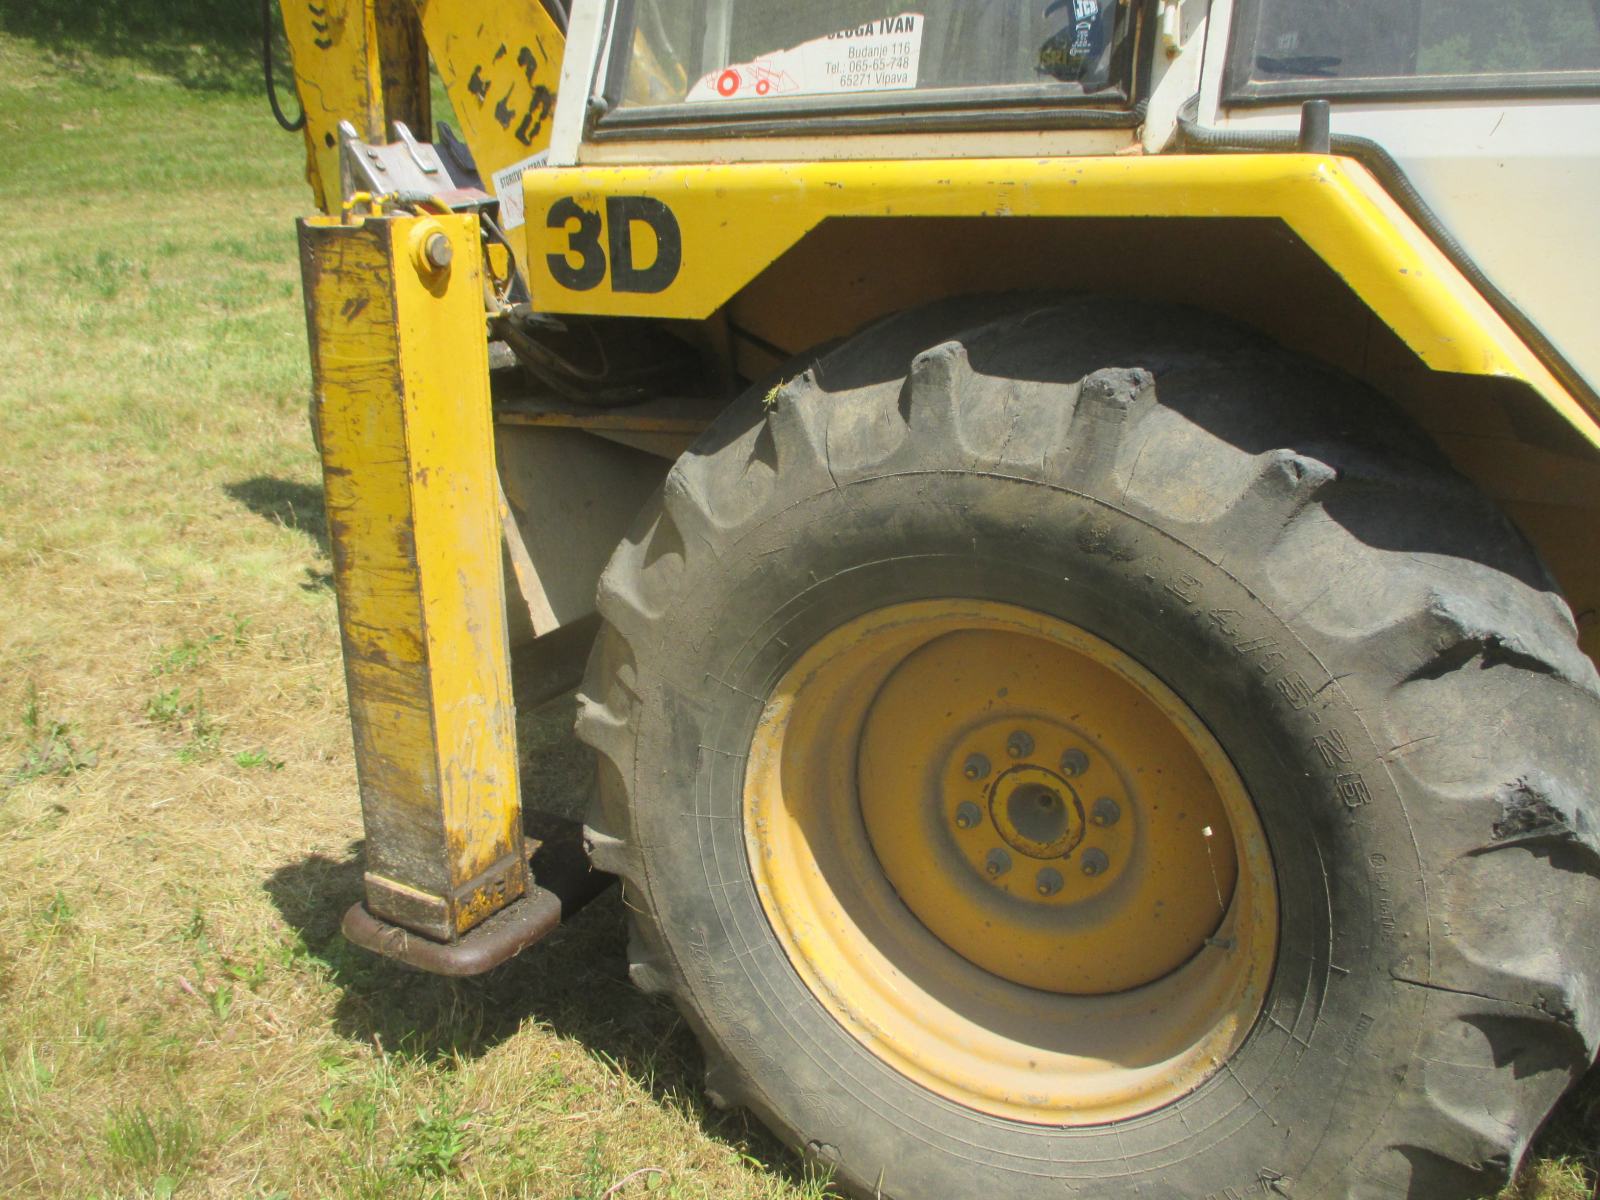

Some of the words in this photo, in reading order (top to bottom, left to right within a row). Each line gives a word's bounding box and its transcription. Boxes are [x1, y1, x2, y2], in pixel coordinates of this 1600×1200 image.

[879, 16, 915, 34] IVAN
[848, 43, 888, 59] Budanje
[892, 42, 911, 55] 116
[849, 57, 909, 73] 065-65-748
[840, 74, 871, 87] 65271
[875, 72, 908, 87] Vipava
[546, 195, 682, 294] 3D
